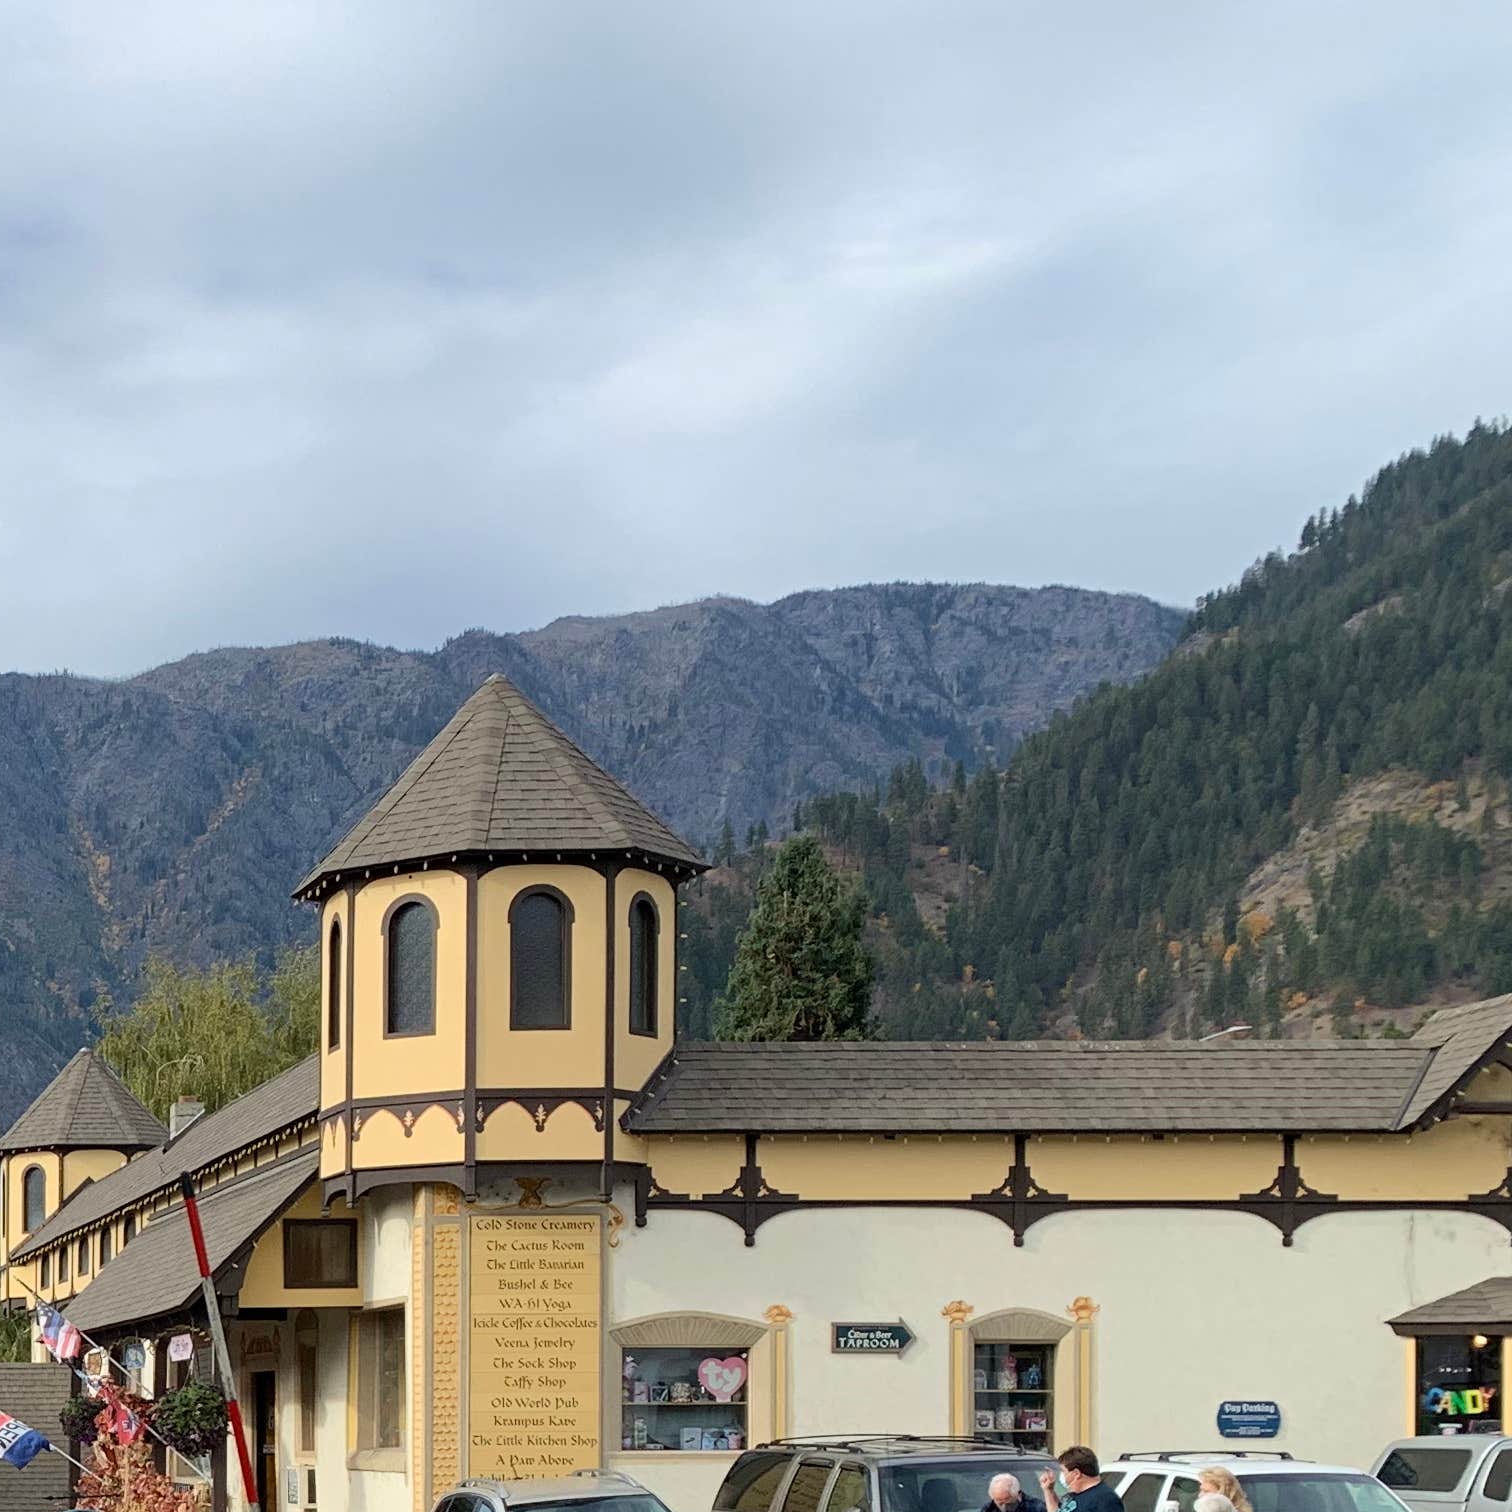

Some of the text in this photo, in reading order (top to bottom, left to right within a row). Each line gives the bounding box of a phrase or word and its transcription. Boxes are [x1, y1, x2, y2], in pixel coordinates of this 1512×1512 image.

[476, 1219, 595, 1232] Cold Stone Creamery
[486, 1240, 585, 1251] The Cactus Room
[486, 1259, 506, 1270] The
[509, 1259, 535, 1270] Little
[498, 1279, 573, 1290] Bushel & Bee
[543, 1297, 571, 1311] Yoga
[502, 1317, 533, 1330] Coffee
[544, 1317, 598, 1328] Chocolates
[533, 1337, 575, 1350] Jewelry
[838, 1337, 899, 1348] TAPROOM
[493, 1357, 577, 1370] The Sock Shop
[504, 1376, 566, 1389] Taffy Shop
[702, 1361, 742, 1392] ty
[491, 1397, 579, 1410] Old World Pub
[1425, 1387, 1497, 1415] CANDY
[494, 1415, 545, 1428] Krampus
[472, 1435, 598, 1448] The Little Kitchen Shop
[496, 1454, 575, 1466] A Paw Above
